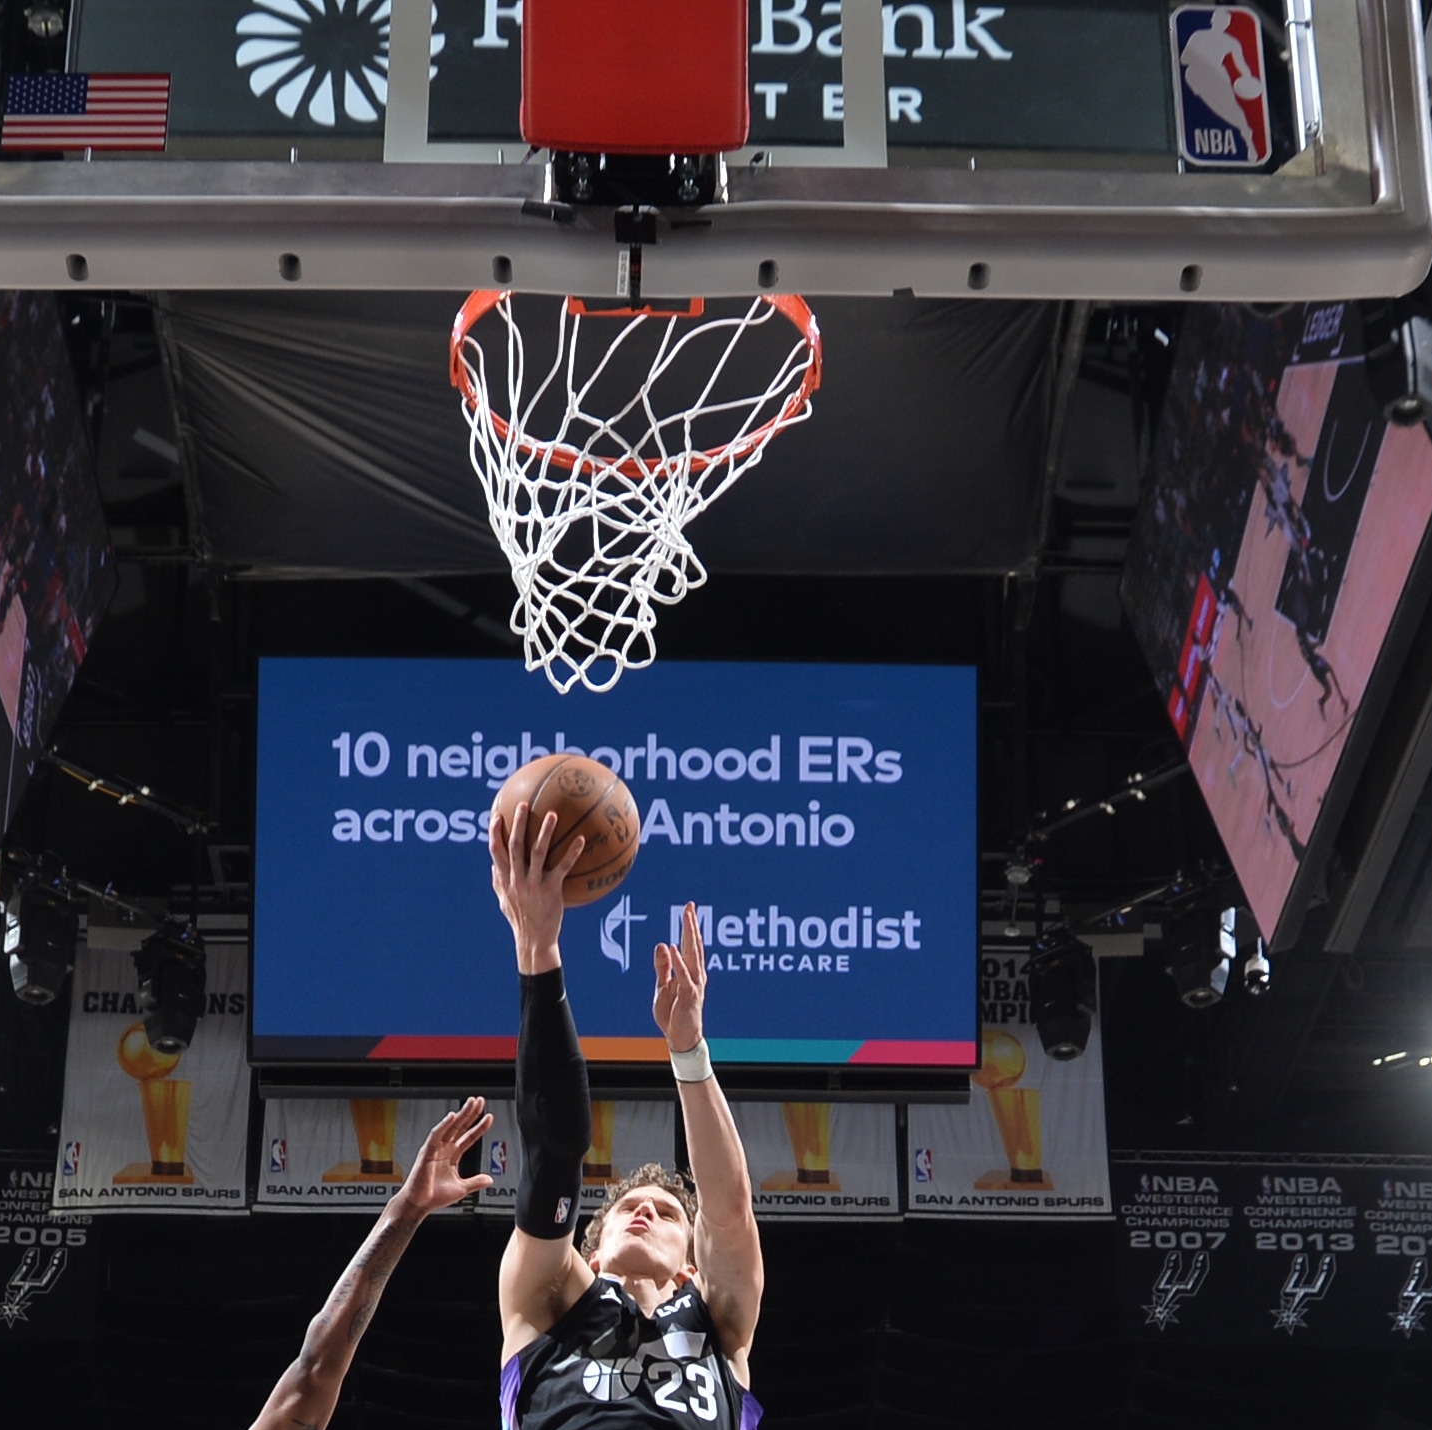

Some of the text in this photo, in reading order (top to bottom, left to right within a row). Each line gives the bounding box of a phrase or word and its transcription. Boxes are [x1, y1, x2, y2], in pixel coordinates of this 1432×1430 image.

[1193, 128, 1238, 157] NBA
[333, 732, 390, 778] 10
[798, 735, 903, 783] ERs
[640, 799, 855, 846] Antonio
[669, 905, 921, 950] Methodist
[706, 953, 850, 972] ALTHCARE
[59, 1186, 240, 1199] SAN ANTONIO SPURS
[266, 1184, 388, 1196] SAN ANTONIO
[1151, 1177, 1220, 1193] NBA
[1273, 1177, 1342, 1193] NBA
[830, 1194, 890, 1208] SPURS
[915, 1194, 1104, 1209] SAN ANTONIO SPURS
[1130, 1231, 1227, 1249] 2007
[1255, 1233, 1355, 1251] 2013
[648, 1362, 718, 1421] 23
